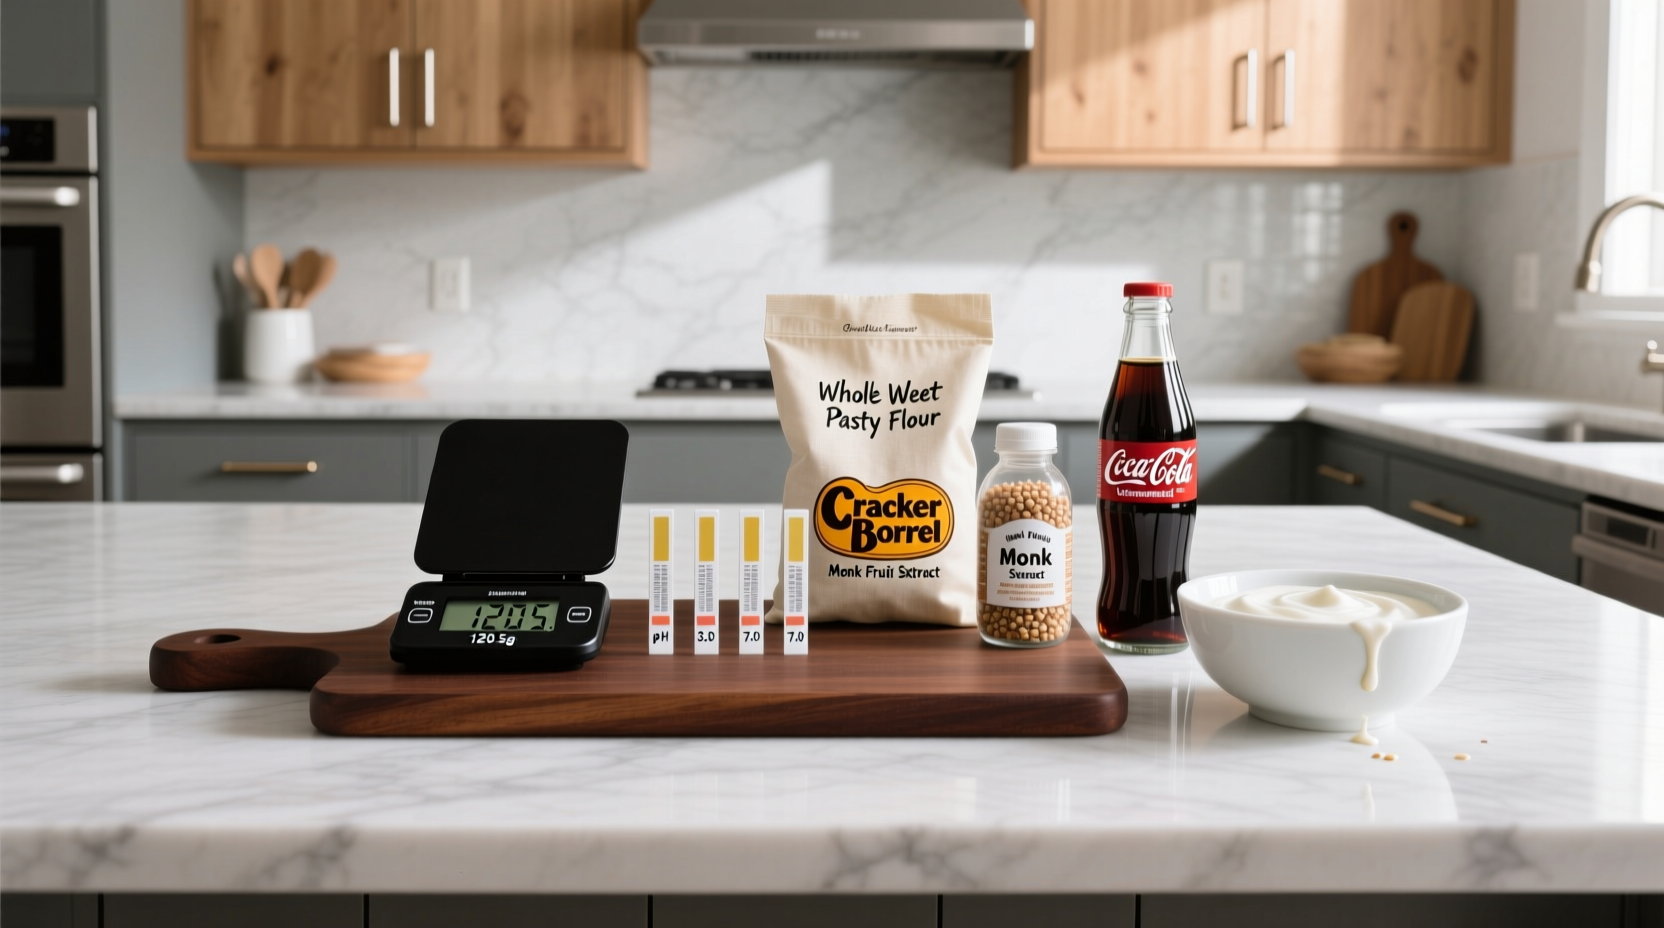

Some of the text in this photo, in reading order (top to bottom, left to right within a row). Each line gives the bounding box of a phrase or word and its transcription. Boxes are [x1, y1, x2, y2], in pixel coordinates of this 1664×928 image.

[888, 380, 943, 405] Weet
[826, 406, 941, 440] Pasty Flour
[821, 485, 942, 531] Cracker
[850, 518, 941, 553] Borrel
[999, 547, 1053, 566] Monk
[828, 564, 862, 578] Monk
[653, 631, 669, 644] pH
[697, 631, 715, 642] 3.0
[743, 631, 760, 642] 7.0
[787, 631, 804, 642] 7.0
